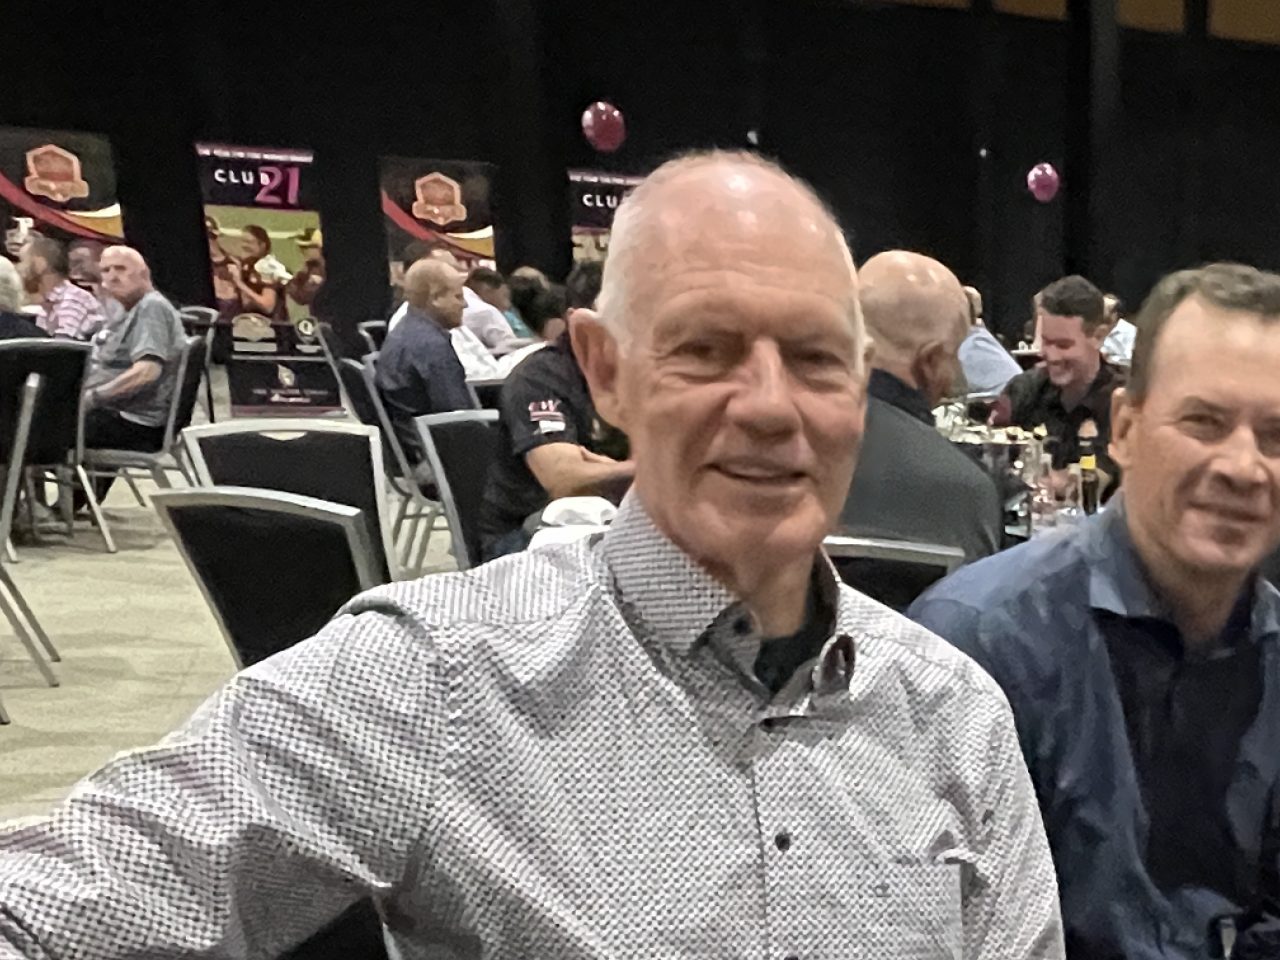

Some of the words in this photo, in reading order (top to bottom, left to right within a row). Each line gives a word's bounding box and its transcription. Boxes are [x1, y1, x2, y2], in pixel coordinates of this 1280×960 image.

[214, 168, 270, 186] CLUB
[255, 166, 300, 205] 21
[582, 193, 618, 208] CLU
